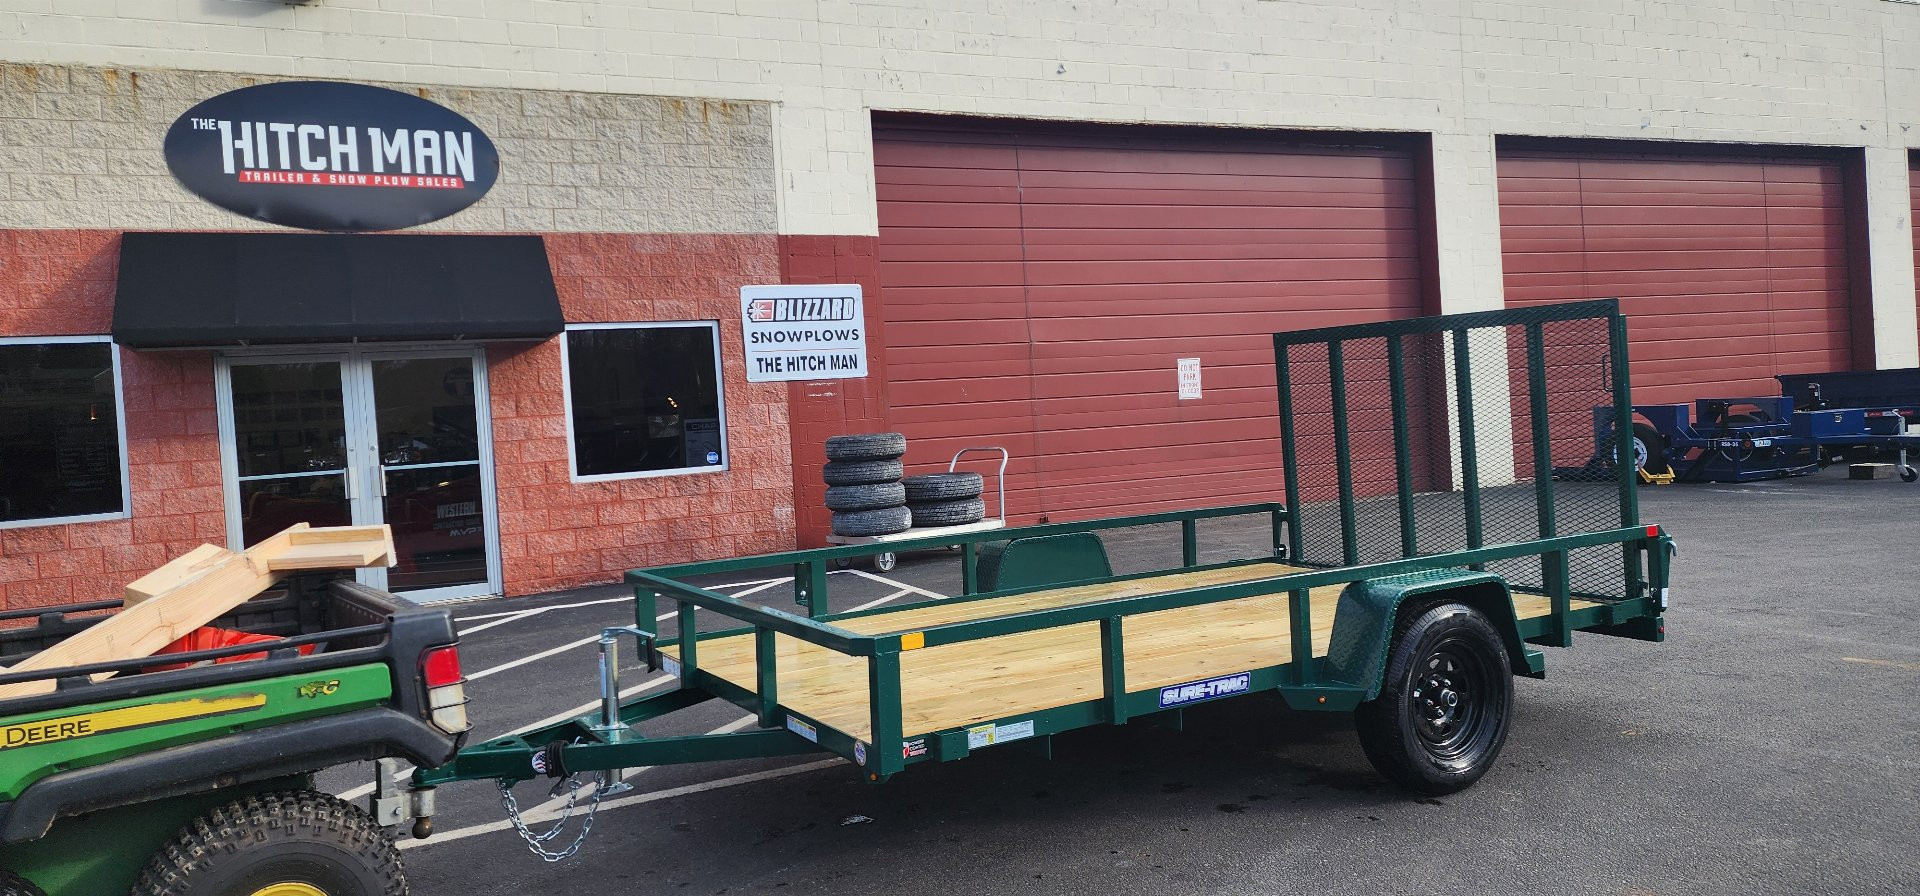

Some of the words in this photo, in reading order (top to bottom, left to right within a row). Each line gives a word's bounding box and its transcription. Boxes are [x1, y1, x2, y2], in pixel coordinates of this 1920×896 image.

[191, 118, 217, 130] THE
[218, 120, 360, 174] HITCH
[367, 127, 475, 182] MAN
[245, 171, 304, 182] TRAILER
[312, 173, 320, 183] &
[329, 174, 367, 184] SNOW
[374, 176, 410, 186] PLOW
[417, 177, 458, 187] SALES
[775, 297, 855, 321] BLIZZARD
[751, 329, 860, 344] SNOWPLOWS
[756, 357, 783, 373] THE
[786, 355, 826, 372] HITCH
[830, 354, 858, 370] MAN
[437, 501, 476, 518] WESTERN
[1162, 676, 1248, 705] SURE-TRAC
[6, 719, 92, 745] DEERE
